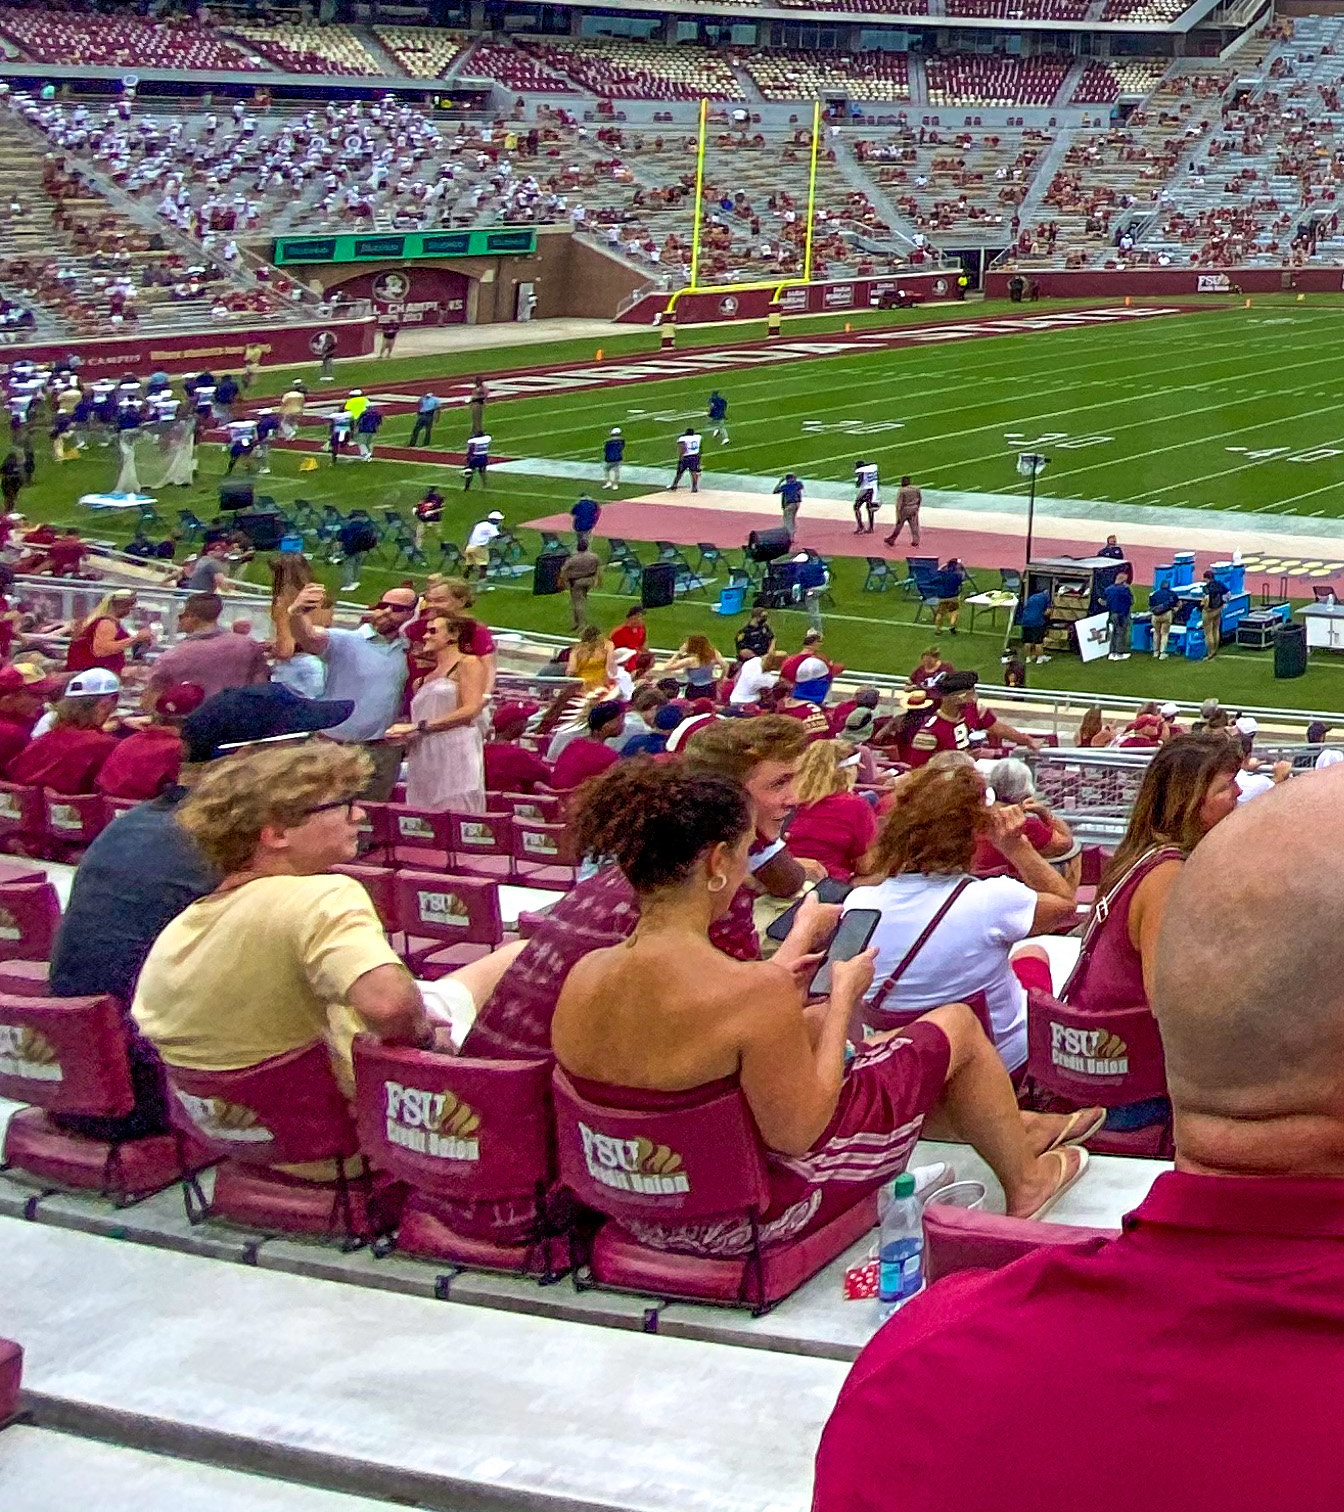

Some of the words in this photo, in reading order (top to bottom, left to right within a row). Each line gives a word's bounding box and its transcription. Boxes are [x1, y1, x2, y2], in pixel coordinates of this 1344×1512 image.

[1049, 1021, 1101, 1057] FSU
[1087, 1056, 1129, 1075] Union
[385, 1081, 446, 1131] FSU
[578, 1121, 641, 1174] FSU
